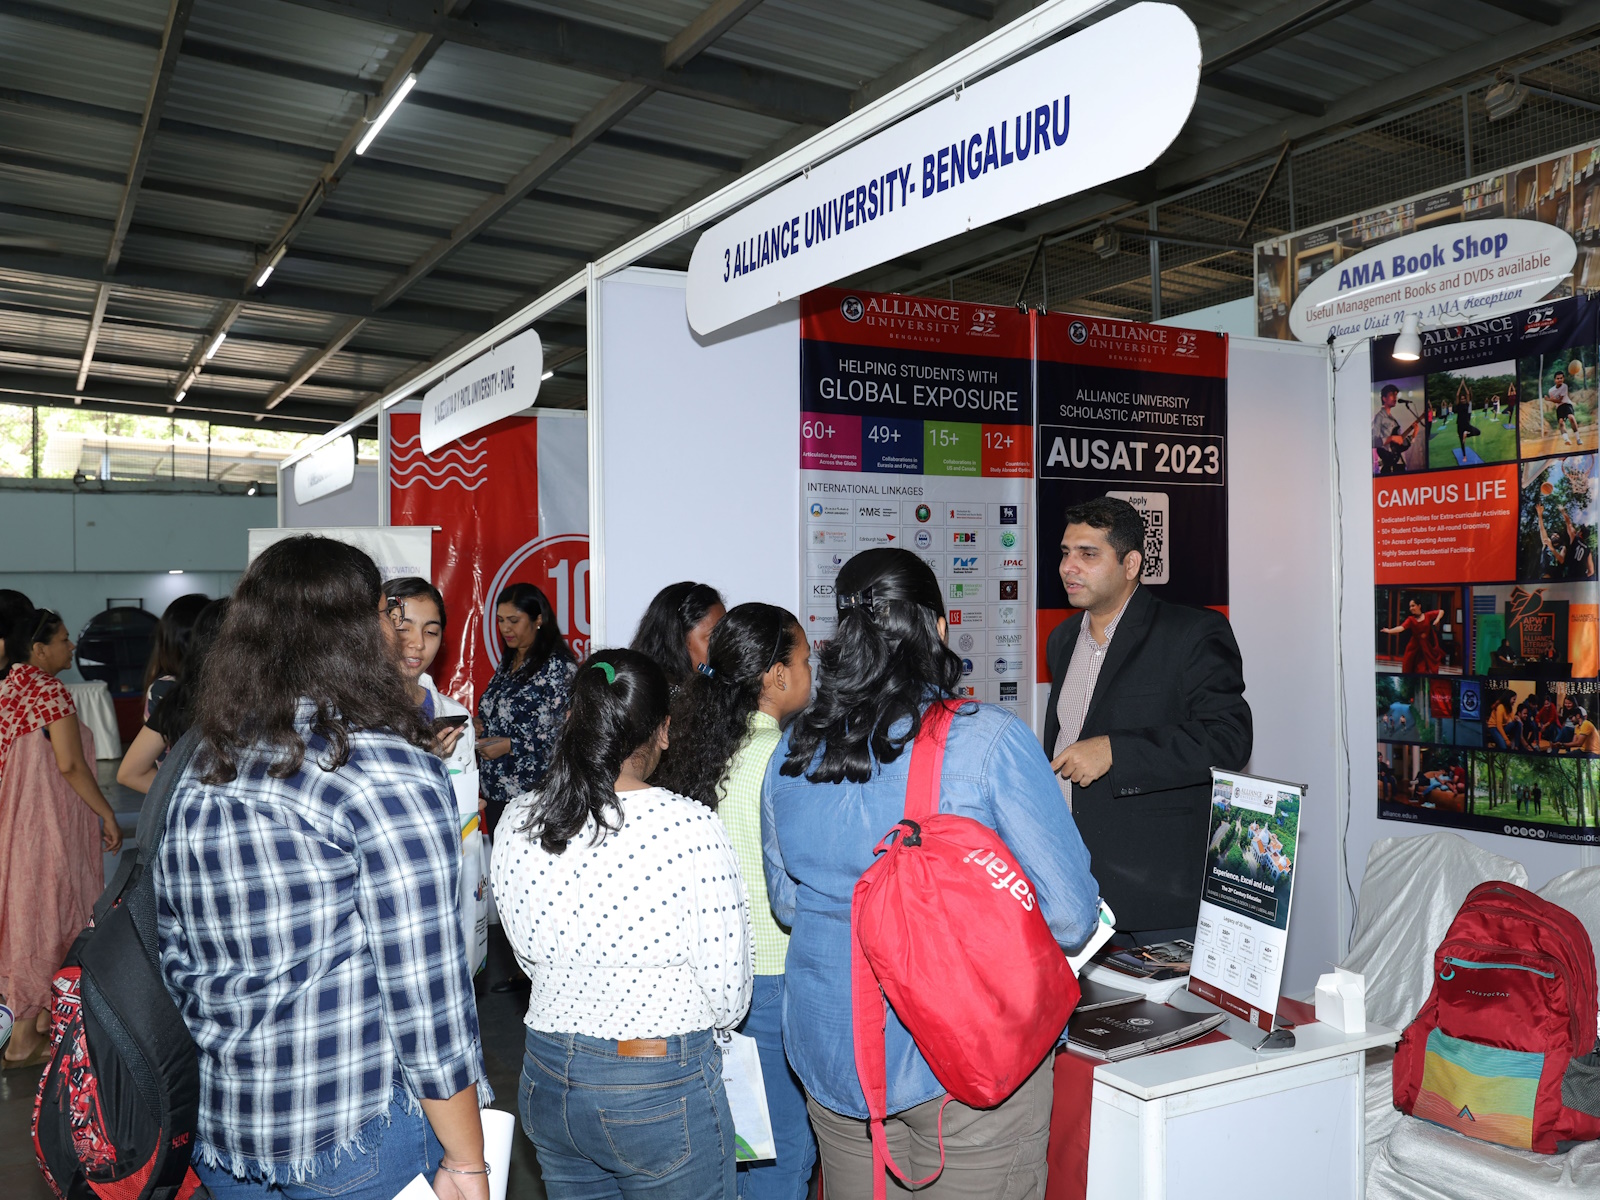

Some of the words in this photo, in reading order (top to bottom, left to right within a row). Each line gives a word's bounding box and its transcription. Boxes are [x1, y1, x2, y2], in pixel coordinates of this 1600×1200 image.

[723, 248, 731, 283] 3
[733, 216, 799, 279] ALLIANCE
[922, 94, 1071, 199] BENGALURU
[1338, 260, 1385, 291] AMA
[1392, 244, 1445, 278] Book
[1452, 232, 1508, 262] Shop
[1306, 304, 1334, 322] Useful
[1336, 289, 1401, 315] Management
[1404, 281, 1436, 300] Books
[1439, 274, 1460, 291] and
[1464, 268, 1494, 286] DVDs
[1497, 253, 1551, 278] available
[866, 297, 960, 321] ALLIANCE
[1364, 314, 1391, 331] Visit
[1427, 300, 1459, 318] AMA
[1463, 288, 1522, 309] Reception
[866, 315, 960, 334] UNIVERSITY
[1090, 322, 1167, 343] ALLIANCE
[889, 333, 941, 343] BENGALURU
[1090, 339, 1167, 355] UNIVERSITY
[1423, 332, 1514, 357] UNIVERSITY
[1109, 355, 1152, 363] BENGALURU
[1443, 351, 1494, 364] BENGALURU
[839, 358, 897, 377] HELPING
[900, 363, 965, 382] STUDENTS
[967, 369, 998, 384] WITH
[819, 377, 907, 406] GLOBAL
[913, 384, 1018, 412] EXPOSURE
[1076, 389, 1130, 405] ALLIANCE
[1132, 394, 1190, 409] UNIVERSITY
[1059, 404, 1129, 421] SCHOLASTIC
[1131, 411, 1179, 426] APTITUDE
[1181, 414, 1205, 427] TEST
[802, 420, 836, 440] 60+
[868, 425, 901, 443] 49+
[929, 429, 960, 447] 15+
[984, 432, 1014, 449] 12+
[1046, 436, 1148, 471] AUSAT
[1154, 442, 1220, 475] 2023
[807, 482, 880, 495] INTERNATIONAL
[881, 486, 924, 496] LINKAGES
[1377, 484, 1459, 508] CAMPUS
[1464, 479, 1507, 502] LIFE
[1128, 496, 1148, 506] Apply
[1440, 510, 1482, 520] Extra-curricular
[1482, 509, 1511, 517] Activities
[1412, 525, 1427, 533] Clubs
[1437, 523, 1461, 531] All-round
[1462, 522, 1490, 530] Grooming
[953, 532, 976, 543] FEDE
[1413, 536, 1437, 545] Sporting
[1398, 548, 1419, 556] Secured
[1420, 547, 1449, 555] Residential
[1450, 546, 1475, 554] Facilities
[1003, 559, 1023, 567] IPAC
[1382, 560, 1402, 568] Massive
[1416, 559, 1435, 567] Courts
[951, 612, 960, 623] LSE
[1523, 624, 1543, 632] 2022
[963, 848, 1036, 912] safari
[1213, 866, 1240, 882] Experience,
[1240, 875, 1253, 886] Excel
[1253, 880, 1262, 889] and
[1262, 883, 1275, 893] Lead
[1465, 989, 1510, 998] ARISTOCRAT
